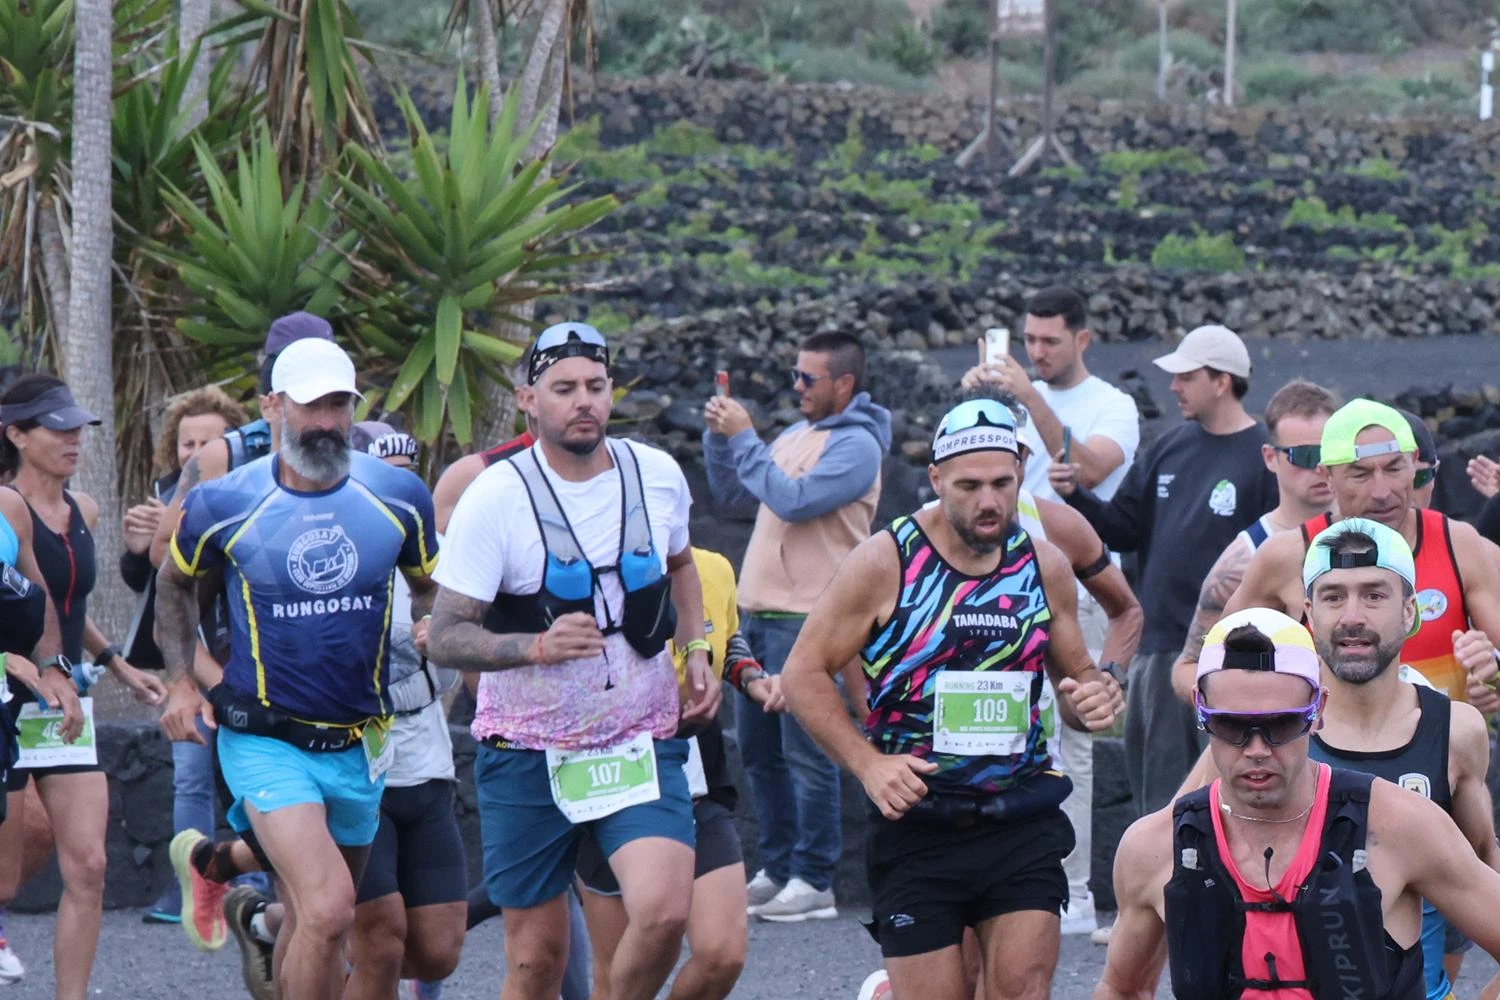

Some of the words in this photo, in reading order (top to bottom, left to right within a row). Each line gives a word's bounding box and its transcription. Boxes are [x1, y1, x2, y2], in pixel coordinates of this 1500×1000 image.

[272, 596, 373, 618] RUNGOSAY
[952, 613, 1018, 630] TAMADABA
[969, 629, 1003, 637] SPORT
[977, 680, 989, 691] 23
[990, 681, 1004, 690] Km
[973, 698, 1008, 723] 109
[588, 761, 622, 788] 107
